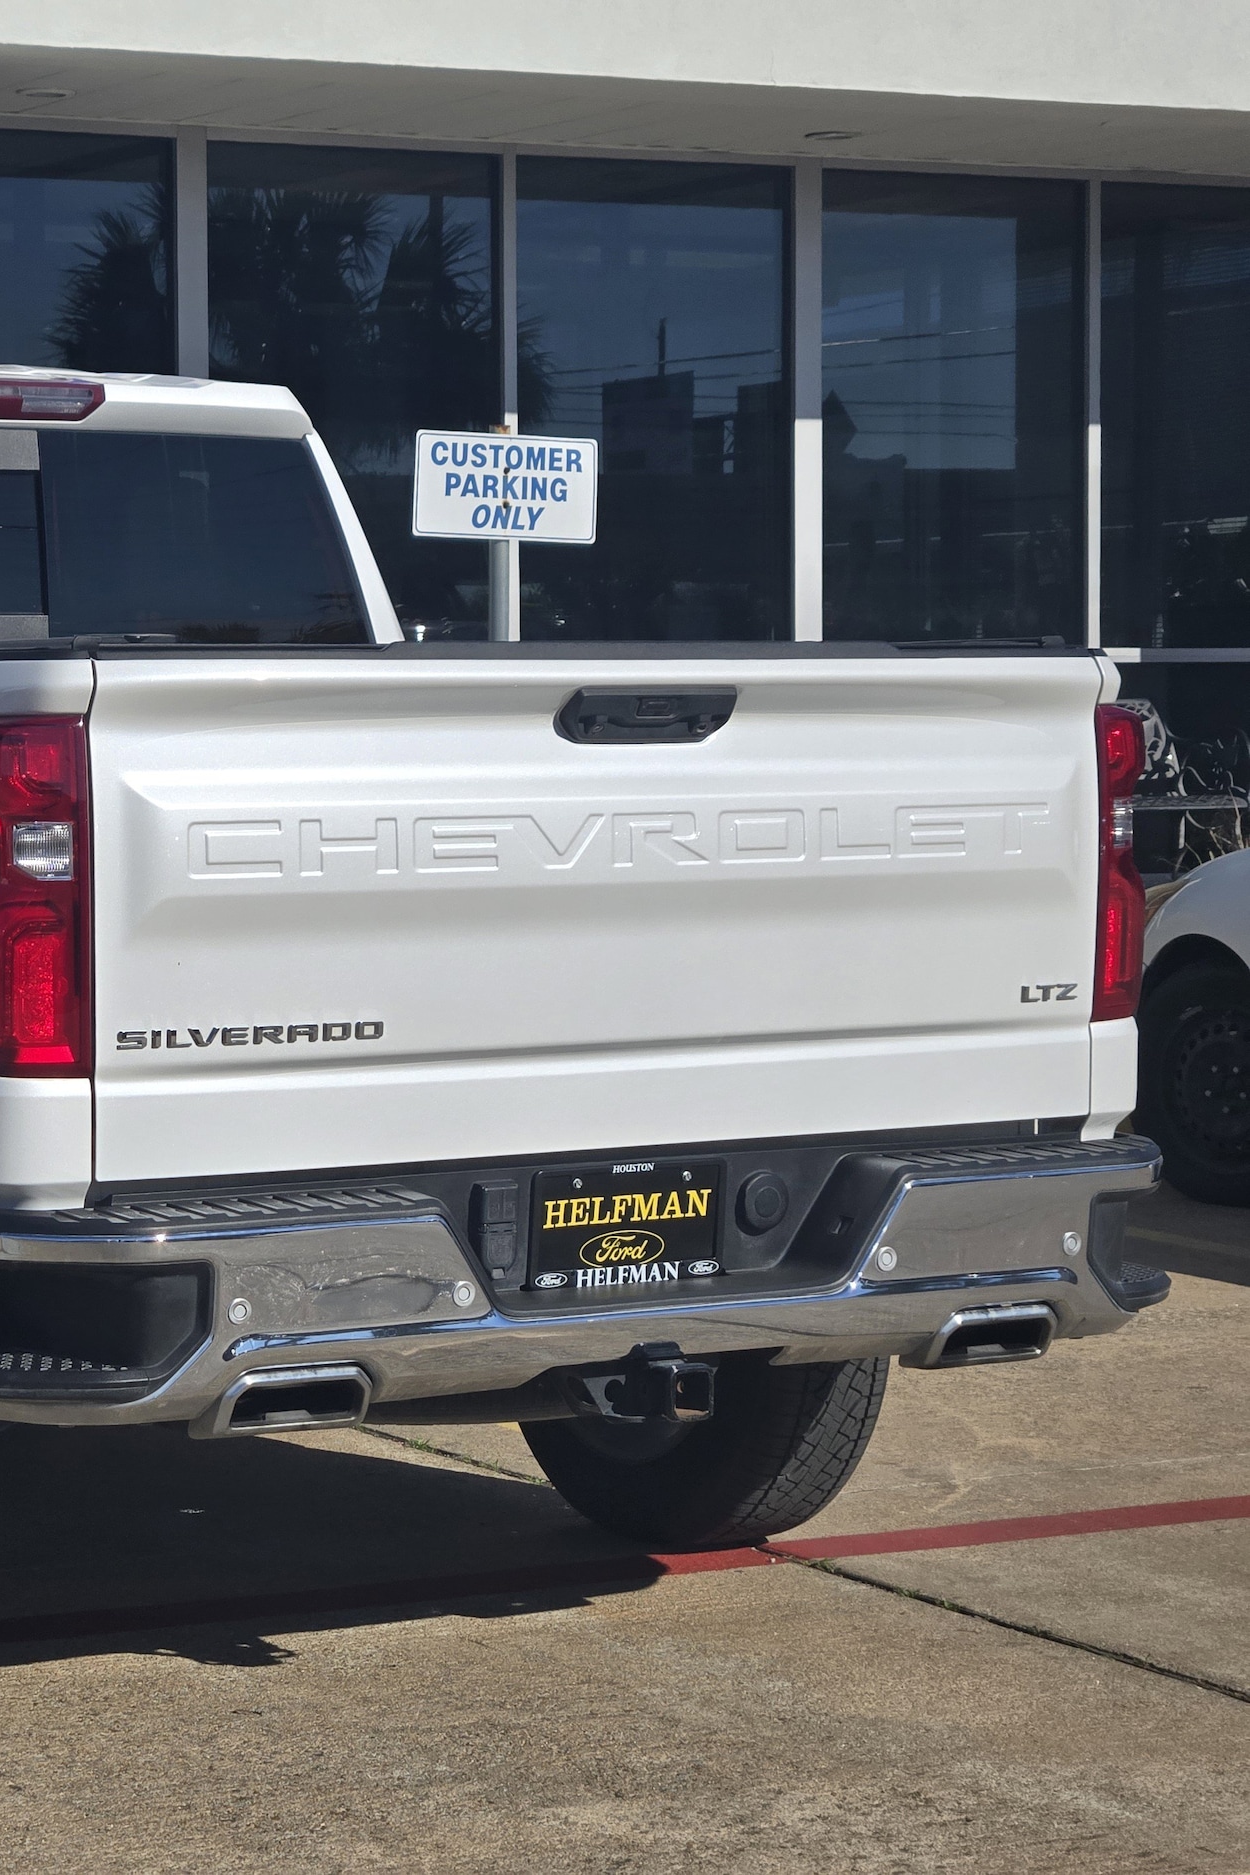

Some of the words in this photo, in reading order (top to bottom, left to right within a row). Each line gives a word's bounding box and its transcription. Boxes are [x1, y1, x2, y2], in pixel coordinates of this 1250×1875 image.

[431, 441, 583, 473] CUSTOMER
[444, 473, 568, 502] PARKING
[471, 504, 545, 531] ONLY
[187, 802, 1050, 879] CHEVROLET
[1020, 983, 1078, 1003] LTZ
[116, 1021, 384, 1050] SILVERADO
[612, 1163, 655, 1174] HOUSTON
[543, 1189, 712, 1229] HELFMAN
[595, 1235, 649, 1262] Ford
[539, 1275, 562, 1286] Ford
[576, 1261, 680, 1288] HELFMAN
[693, 1262, 715, 1273] Ford
